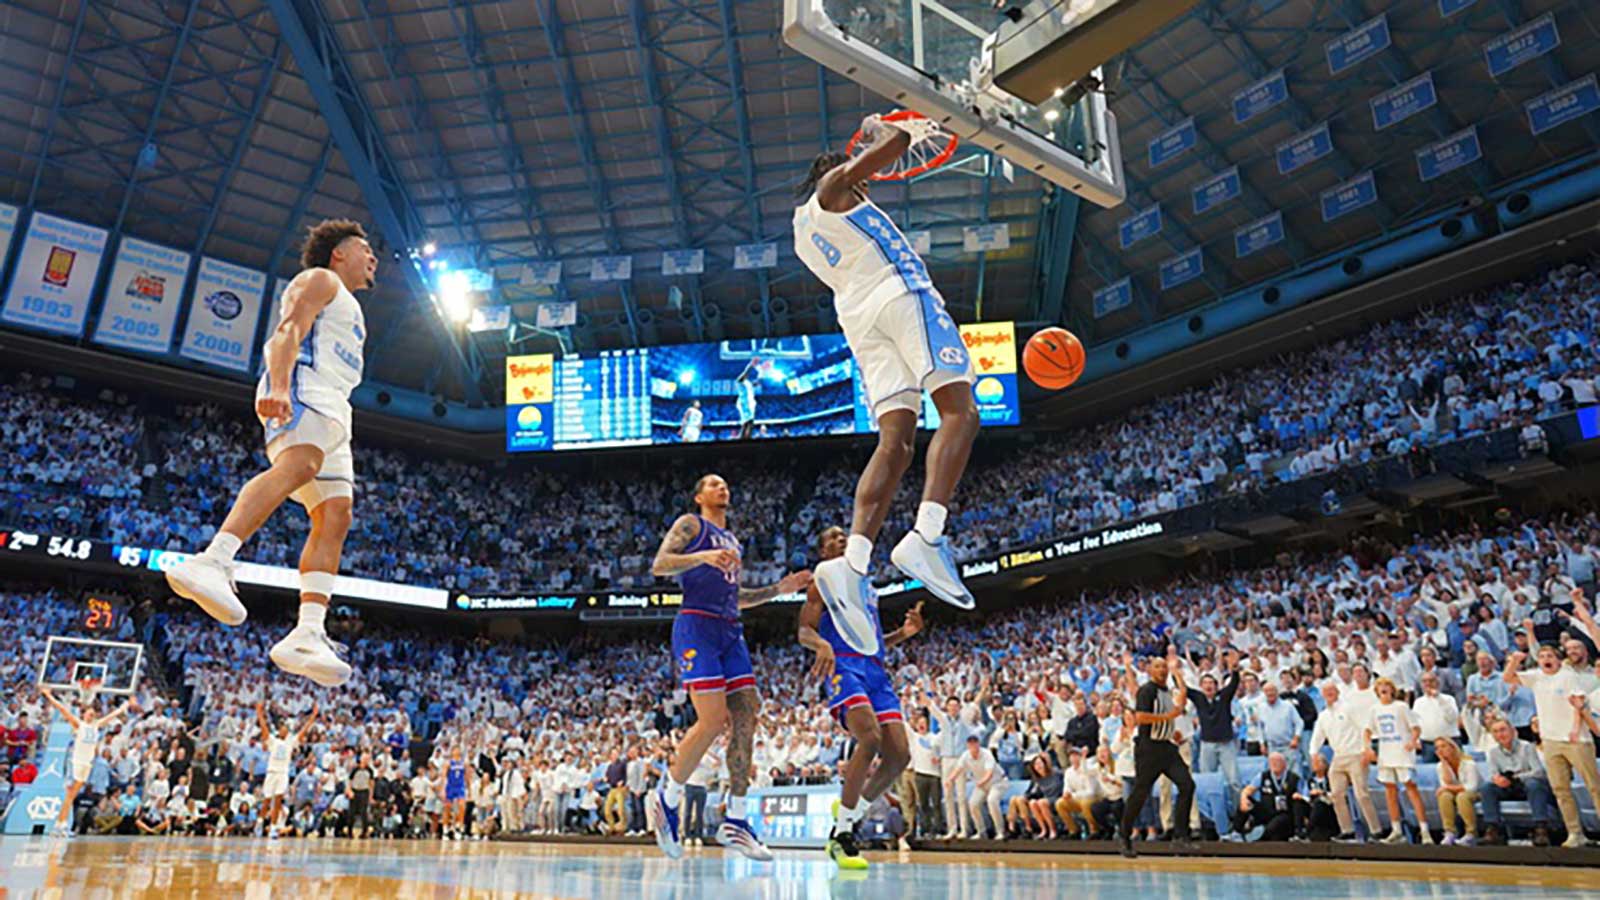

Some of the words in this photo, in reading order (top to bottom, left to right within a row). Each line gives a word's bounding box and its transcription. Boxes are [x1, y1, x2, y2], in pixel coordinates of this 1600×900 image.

[23, 296, 73, 318] 1993
[111, 315, 161, 337] 2005
[193, 331, 244, 356] 2009
[963, 331, 1011, 348] Bojangles
[47, 536, 92, 559] 54.8
[962, 560, 999, 578] Raising
[1009, 550, 1044, 567] Billion
[1044, 547, 1055, 560] a
[1054, 541, 1081, 557] Year
[1082, 536, 1101, 550] for
[1101, 521, 1163, 547] Education
[538, 595, 577, 609] Lottery
[85, 610, 112, 628] 27
